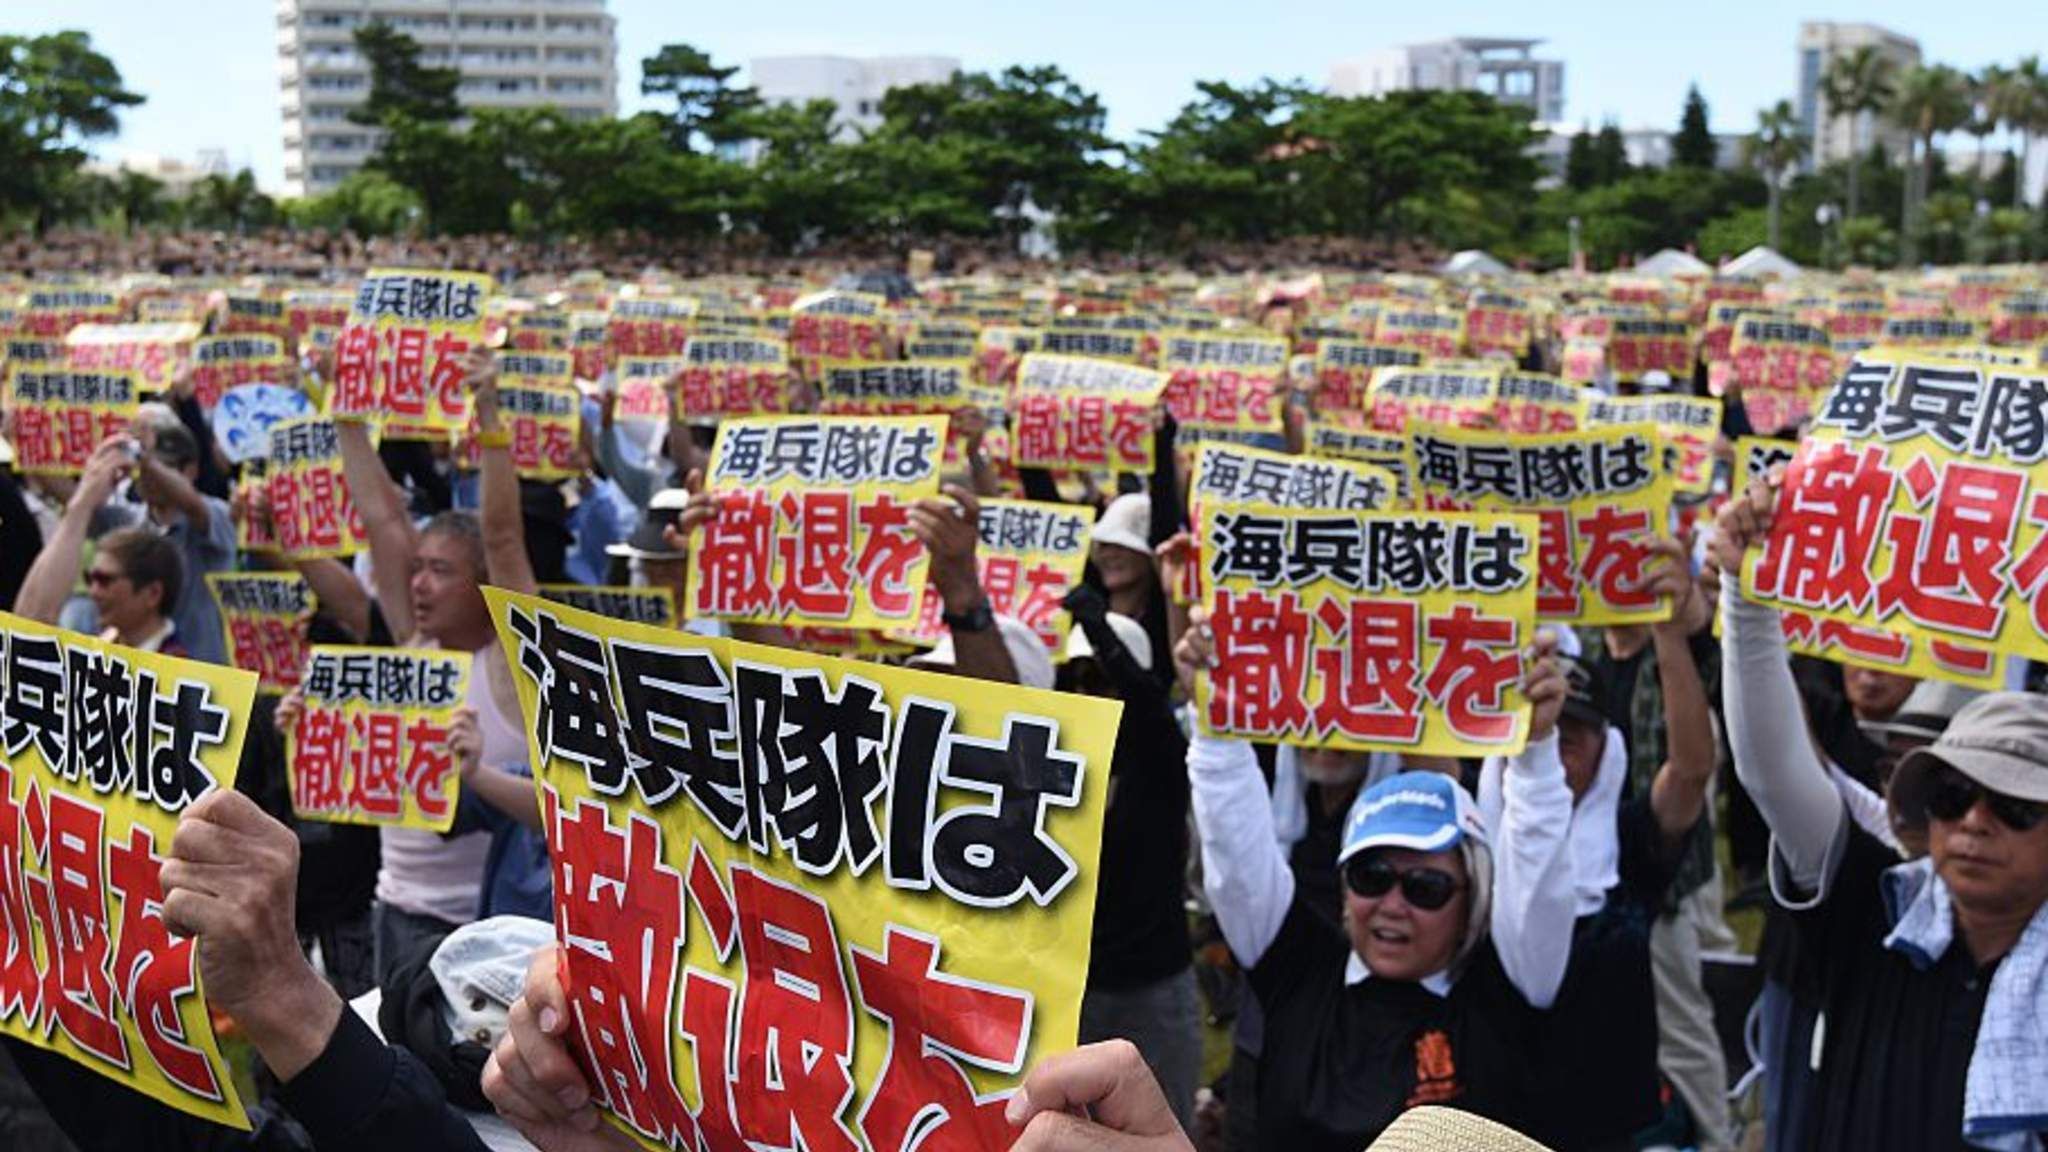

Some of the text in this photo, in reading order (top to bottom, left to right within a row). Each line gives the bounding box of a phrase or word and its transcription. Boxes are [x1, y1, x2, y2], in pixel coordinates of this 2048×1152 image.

[334, 324, 469, 416] 撤退を
[1165, 369, 1280, 423] 撤退を
[272, 420, 338, 466] 海兵隊
[714, 422, 938, 484] 海兵隊は
[1018, 395, 1148, 464] 撤退を
[1412, 434, 1652, 503] 海兵隊は
[1198, 449, 1386, 509] 海兵隊は
[696, 486, 926, 618] 撤退を
[1208, 511, 1526, 594] 海兵隊は
[1207, 587, 1525, 742] 撤退を
[0, 630, 230, 811] 兵隊は
[508, 602, 1083, 907] 海兵隊は
[293, 707, 459, 819] 撤退を
